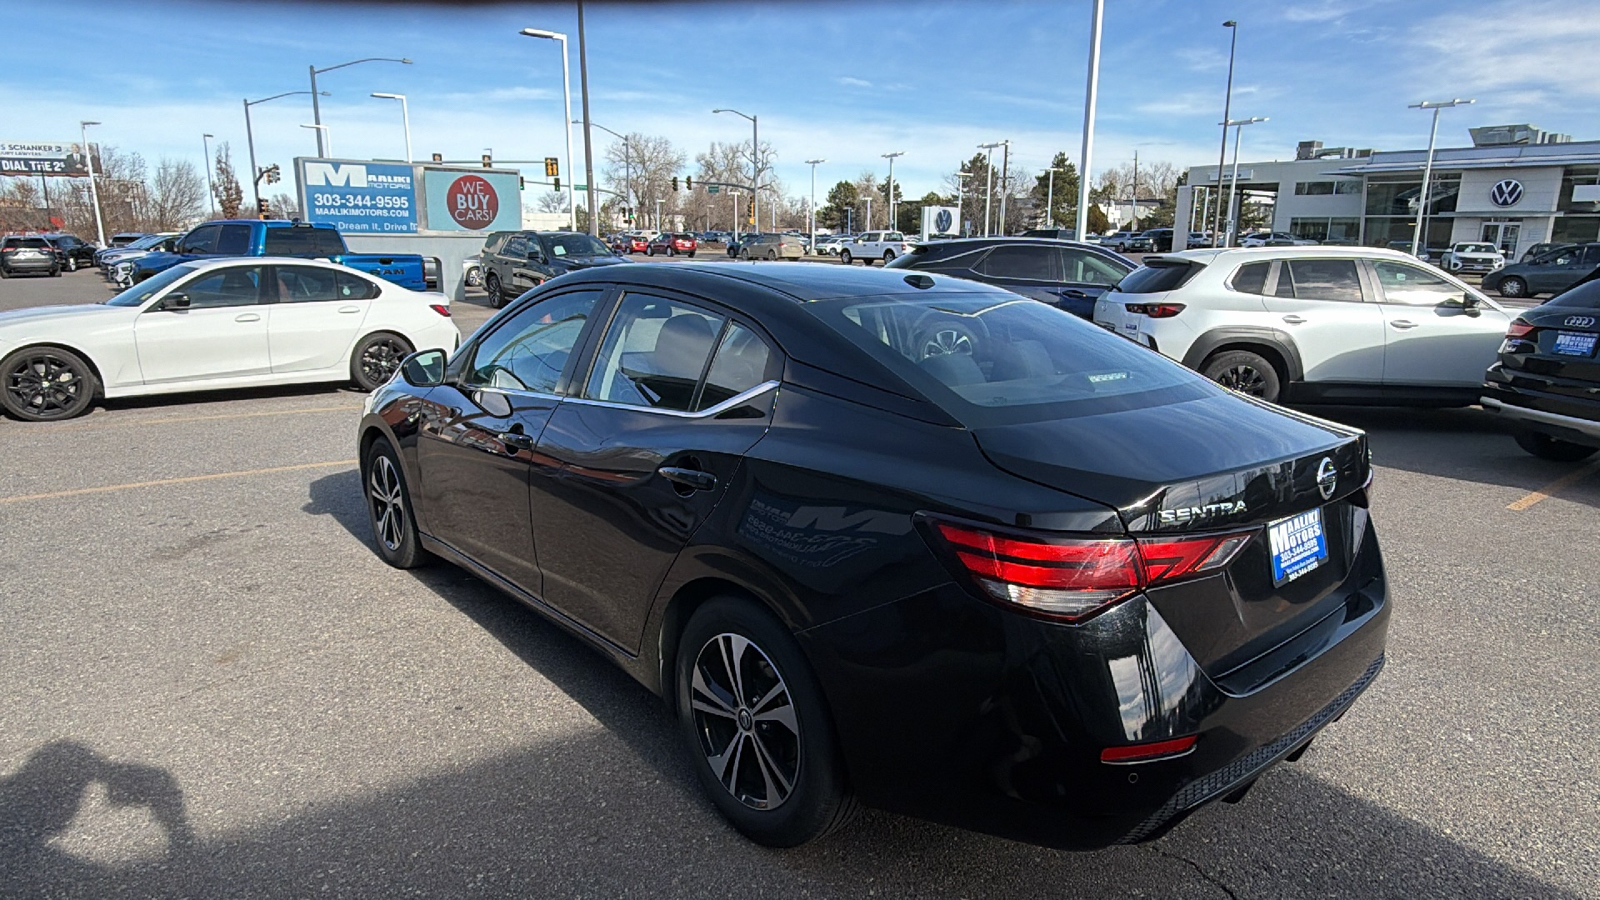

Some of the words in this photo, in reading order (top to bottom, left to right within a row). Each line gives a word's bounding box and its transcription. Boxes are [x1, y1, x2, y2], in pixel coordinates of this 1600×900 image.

[2, 160, 28, 171] DIAL
[305, 162, 410, 187] MAALIKI
[461, 181, 484, 194] WE
[314, 193, 408, 208] 303-344-9595
[457, 193, 490, 209] BUY
[315, 207, 409, 217] MAALIKIMOTORS.COM
[455, 209, 493, 221] CARS!
[337, 221, 369, 230] Dream
[384, 222, 407, 231] Drive
[1158, 500, 1248, 523] SENTRA
